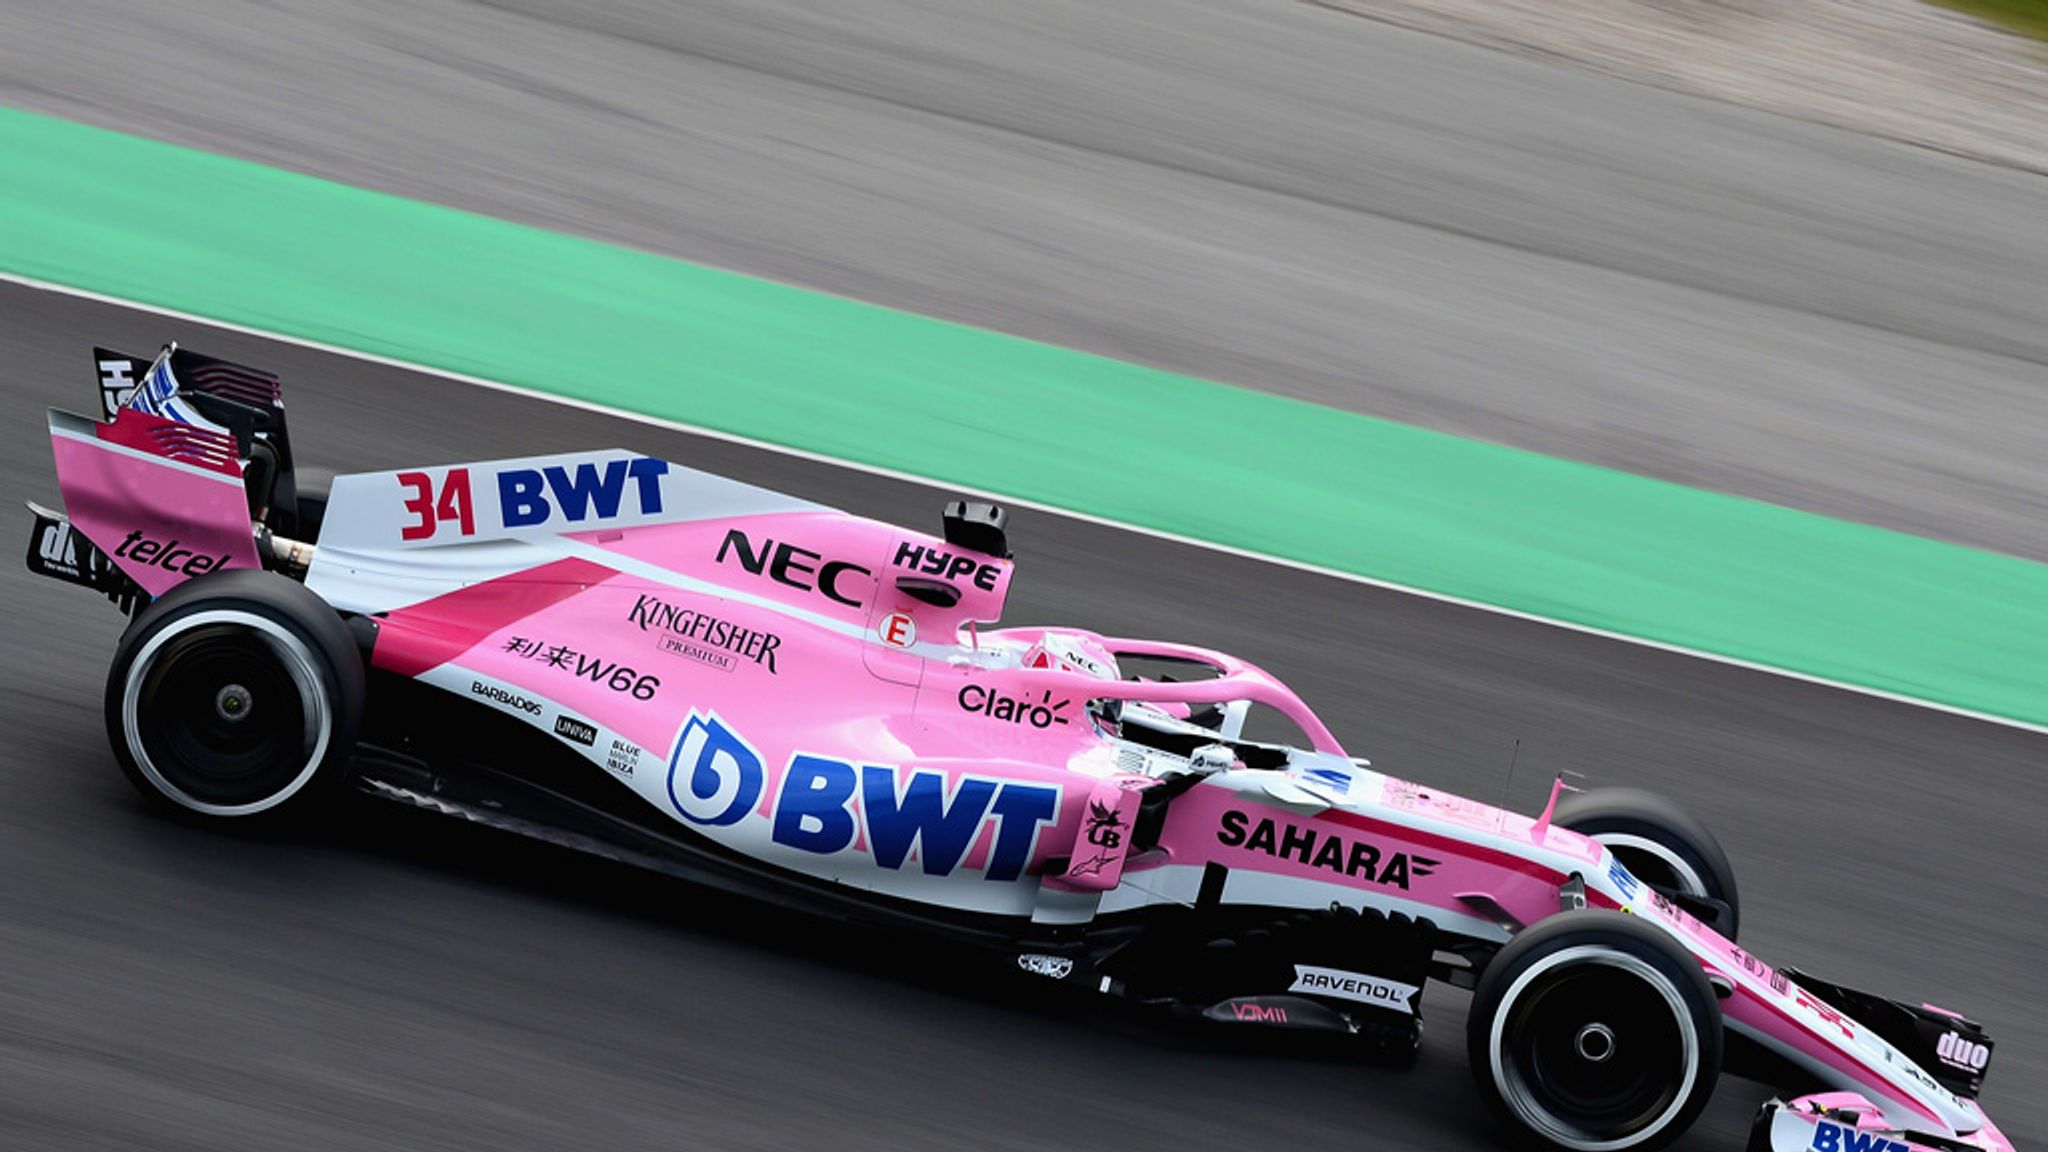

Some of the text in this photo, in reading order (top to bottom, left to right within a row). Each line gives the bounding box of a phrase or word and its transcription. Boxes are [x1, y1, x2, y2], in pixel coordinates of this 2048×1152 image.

[396, 457, 669, 541] 34 BWT
[715, 528, 871, 608] NEC
[893, 542, 1001, 592] HYPE
[628, 594, 782, 675] KINGFISHER
[886, 615, 909, 645] E
[665, 640, 729, 668] PREMIUM
[472, 680, 542, 716] BARBADOS
[958, 684, 1052, 728] Claro
[612, 739, 641, 757] BLUE
[772, 755, 1058, 882] BWT
[1217, 810, 1411, 890] SAHARA
[1302, 973, 1401, 1003] RAVENOL
[1936, 1030, 1989, 1069] duo
